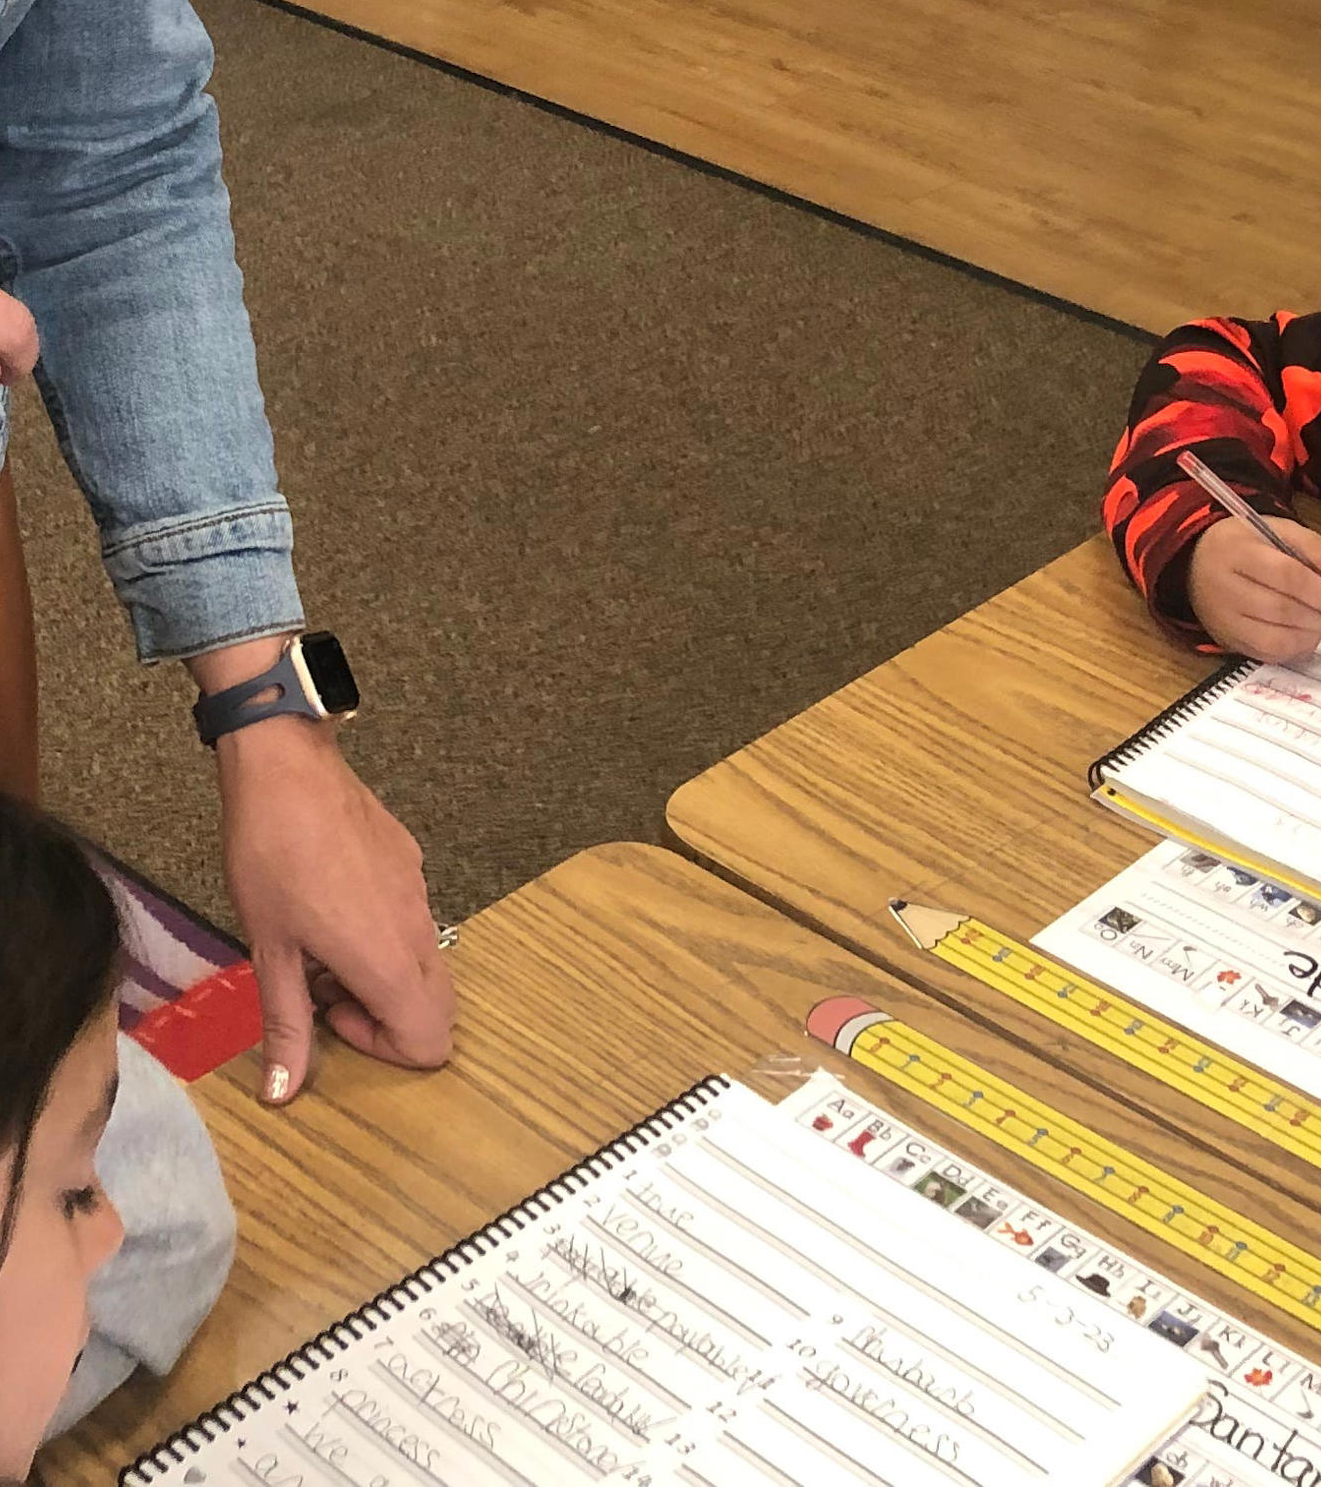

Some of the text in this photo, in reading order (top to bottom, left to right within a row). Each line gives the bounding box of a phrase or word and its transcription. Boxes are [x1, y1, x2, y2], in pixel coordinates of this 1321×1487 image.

[1091, 923, 1118, 942] Oo
[1129, 940, 1155, 961] Nn
[1240, 999, 1263, 1019] Kk
[622, 1168, 695, 1224] 1 true
[543, 1223, 562, 1235] 3
[827, 1098, 855, 1120] Aa
[866, 1117, 893, 1141] Bb
[905, 1141, 932, 1165] Cc
[941, 1164, 975, 1187] Dd
[1019, 1210, 1052, 1233] Ff
[1219, 1324, 1247, 1349] Kk
[583, 1195, 602, 1208] 2
[602, 1203, 684, 1276] venue
[461, 1277, 481, 1294] 5
[418, 1307, 434, 1322] 6
[831, 1313, 845, 1325] 9
[373, 1335, 395, 1350] 7
[785, 1337, 818, 1358] 10
[329, 1367, 349, 1383] 8
[705, 1400, 738, 1424] 12
[663, 1432, 697, 1456] 13
